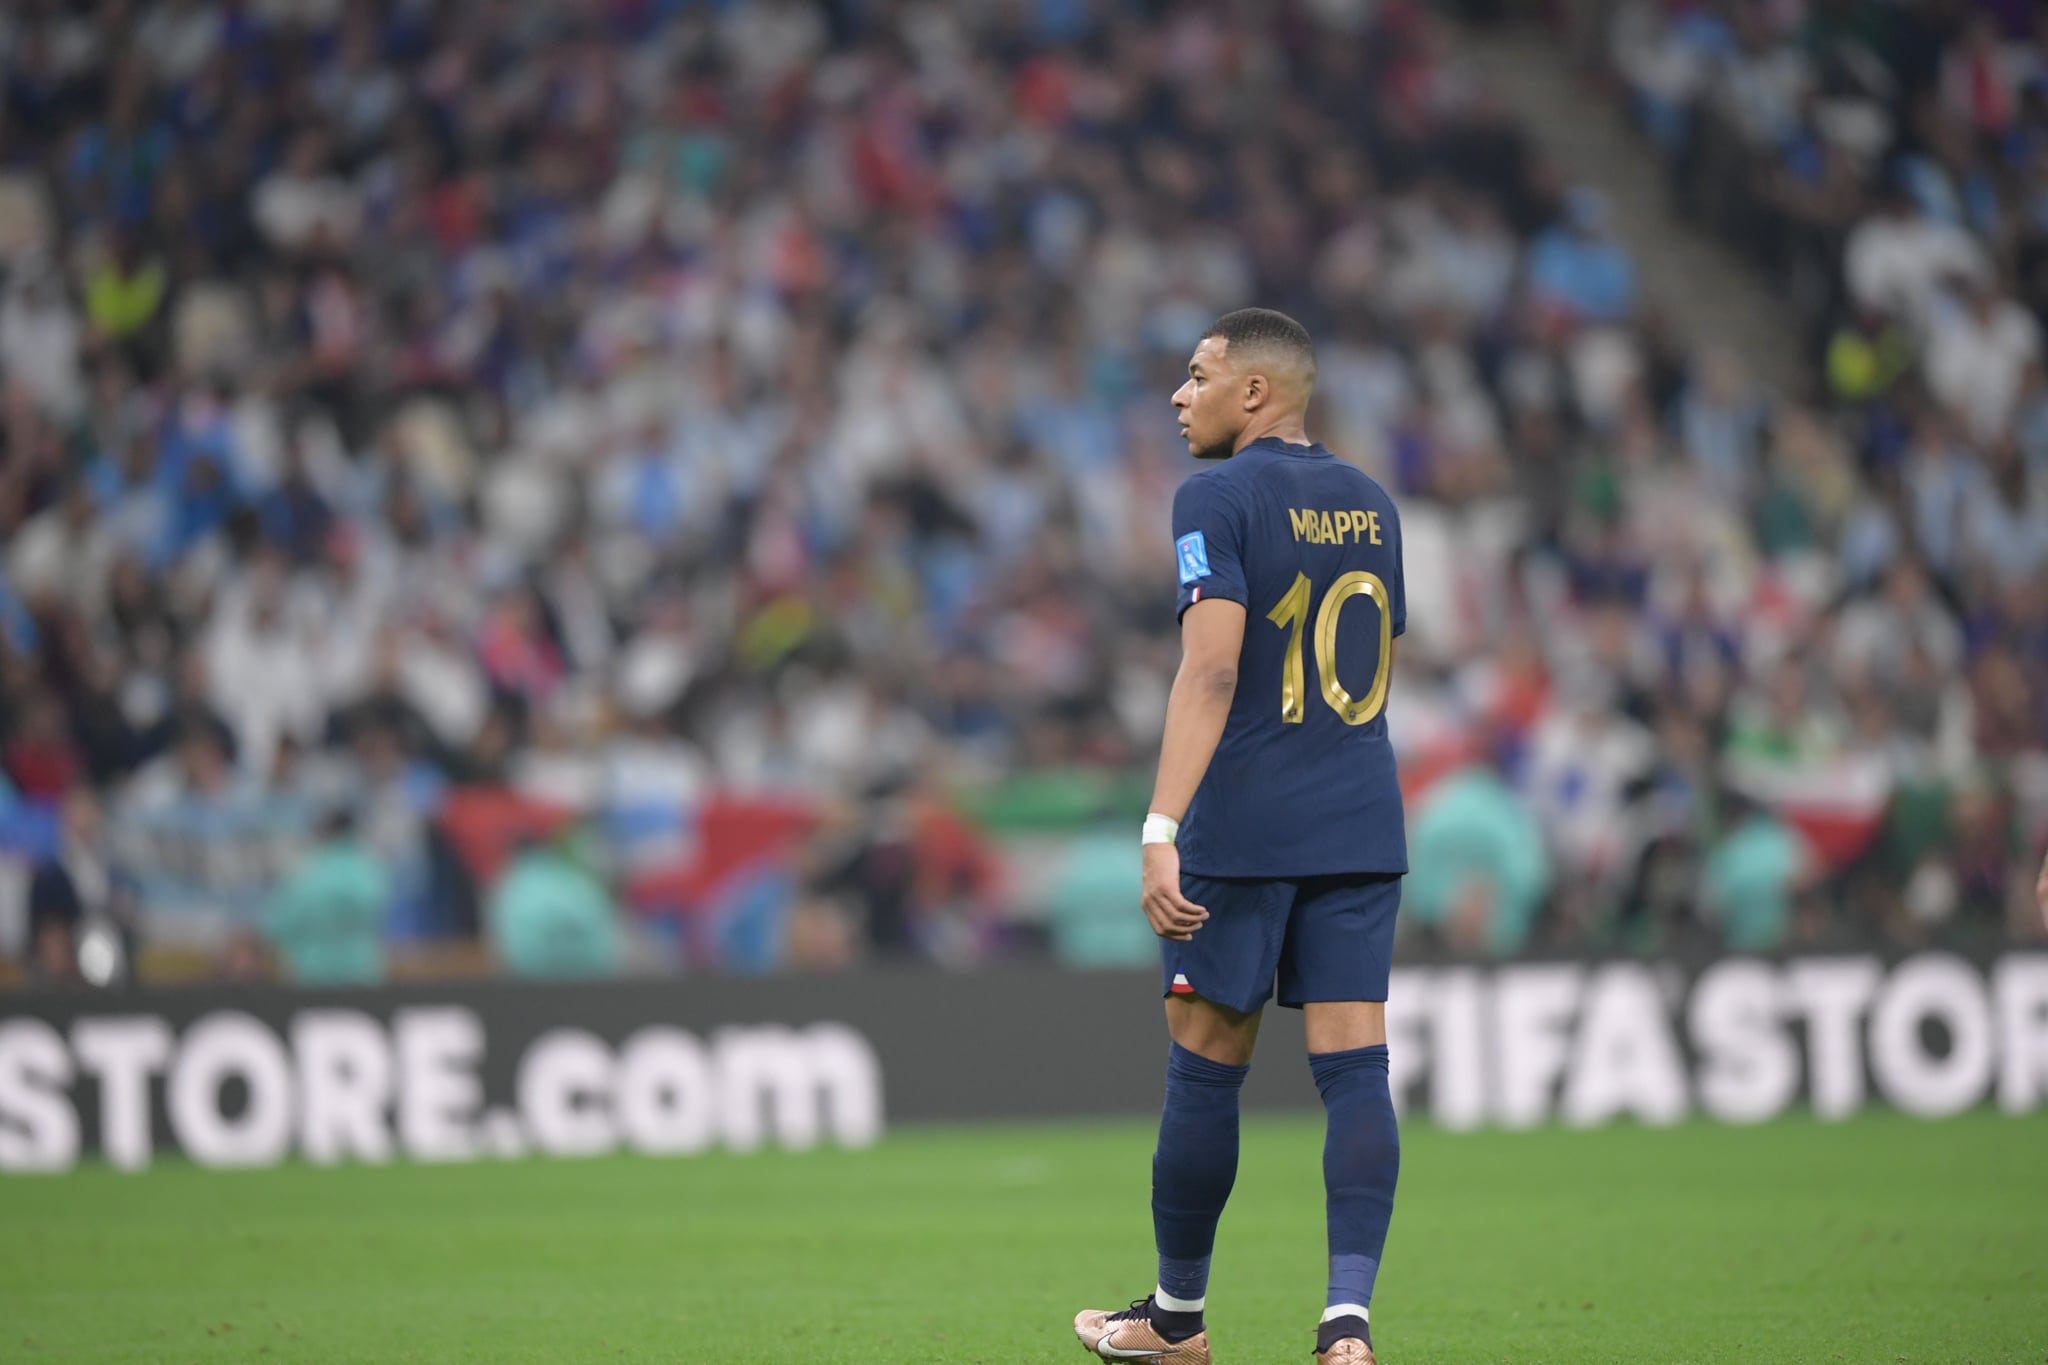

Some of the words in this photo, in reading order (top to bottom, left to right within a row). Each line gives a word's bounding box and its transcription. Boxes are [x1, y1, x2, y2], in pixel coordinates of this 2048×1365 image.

[1288, 508, 1383, 545] MBAPPE
[1265, 570, 1392, 726] 10
[0, 1008, 884, 1174] STORE.com
